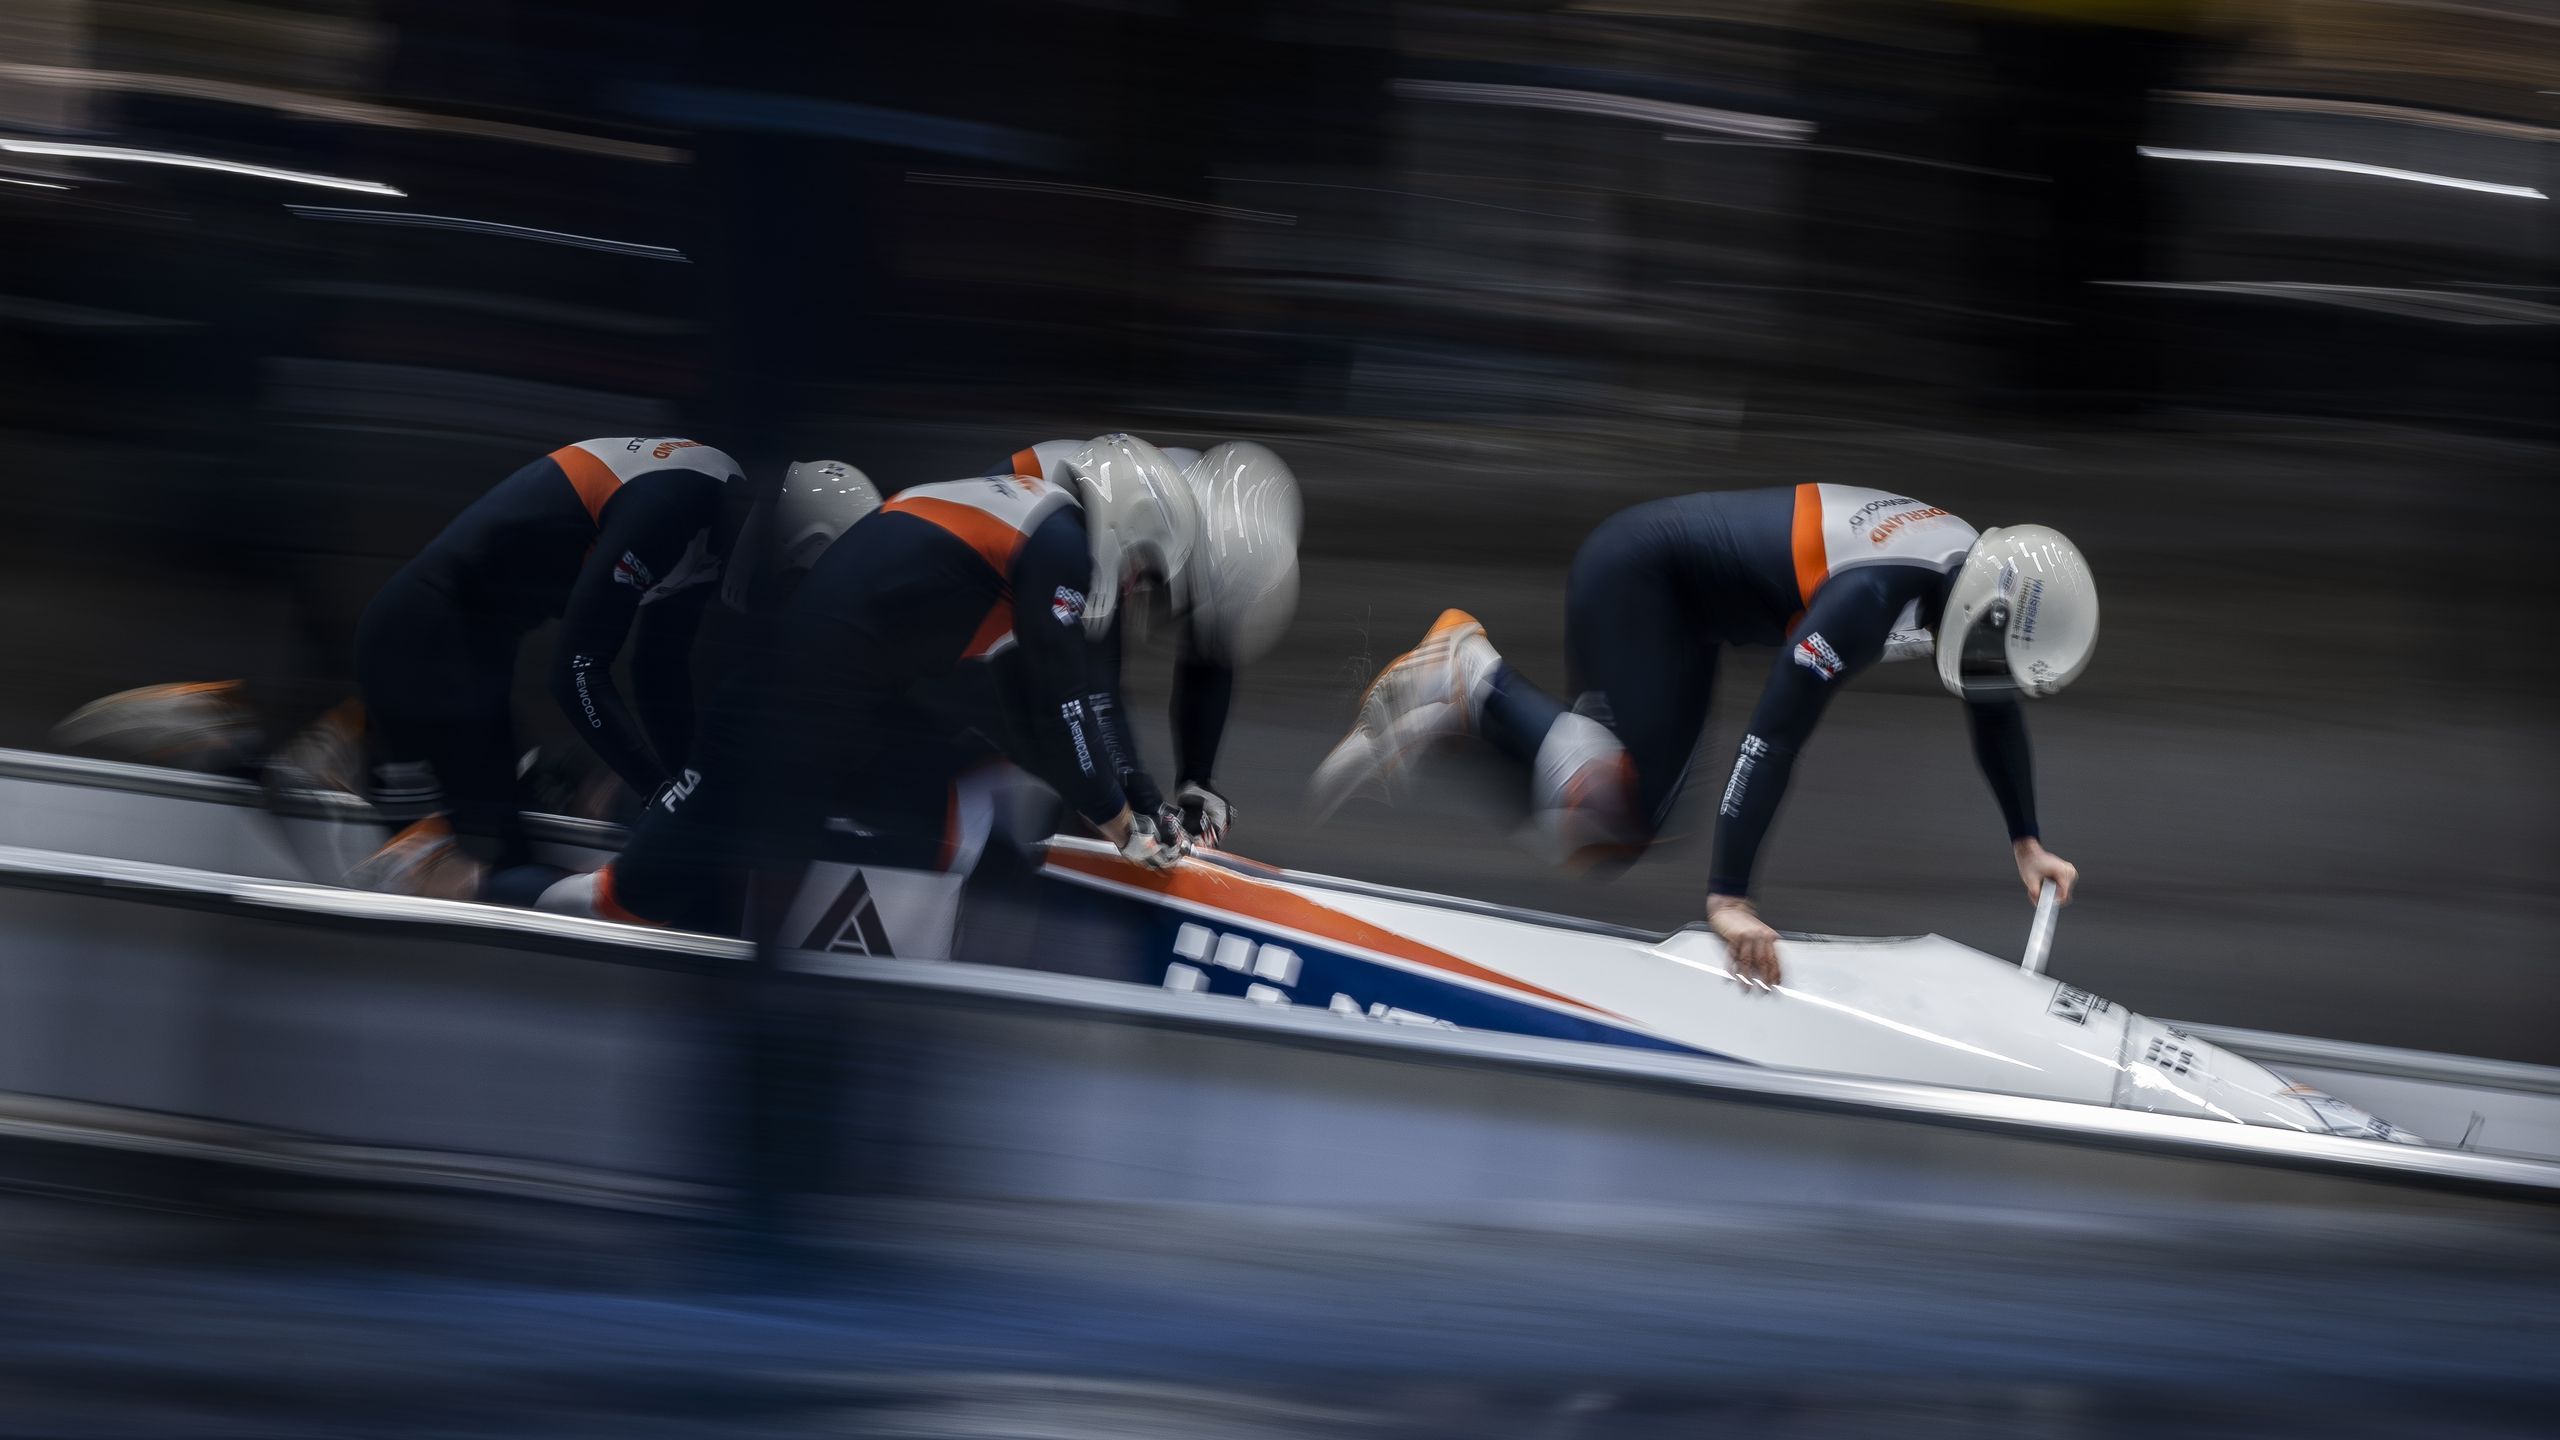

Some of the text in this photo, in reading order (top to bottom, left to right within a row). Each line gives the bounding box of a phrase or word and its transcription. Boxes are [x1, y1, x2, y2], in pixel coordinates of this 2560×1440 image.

[575, 671, 602, 729] NEWCOLD
[1069, 720, 1094, 774] NEWCOLD
[661, 767, 703, 813] FILA
